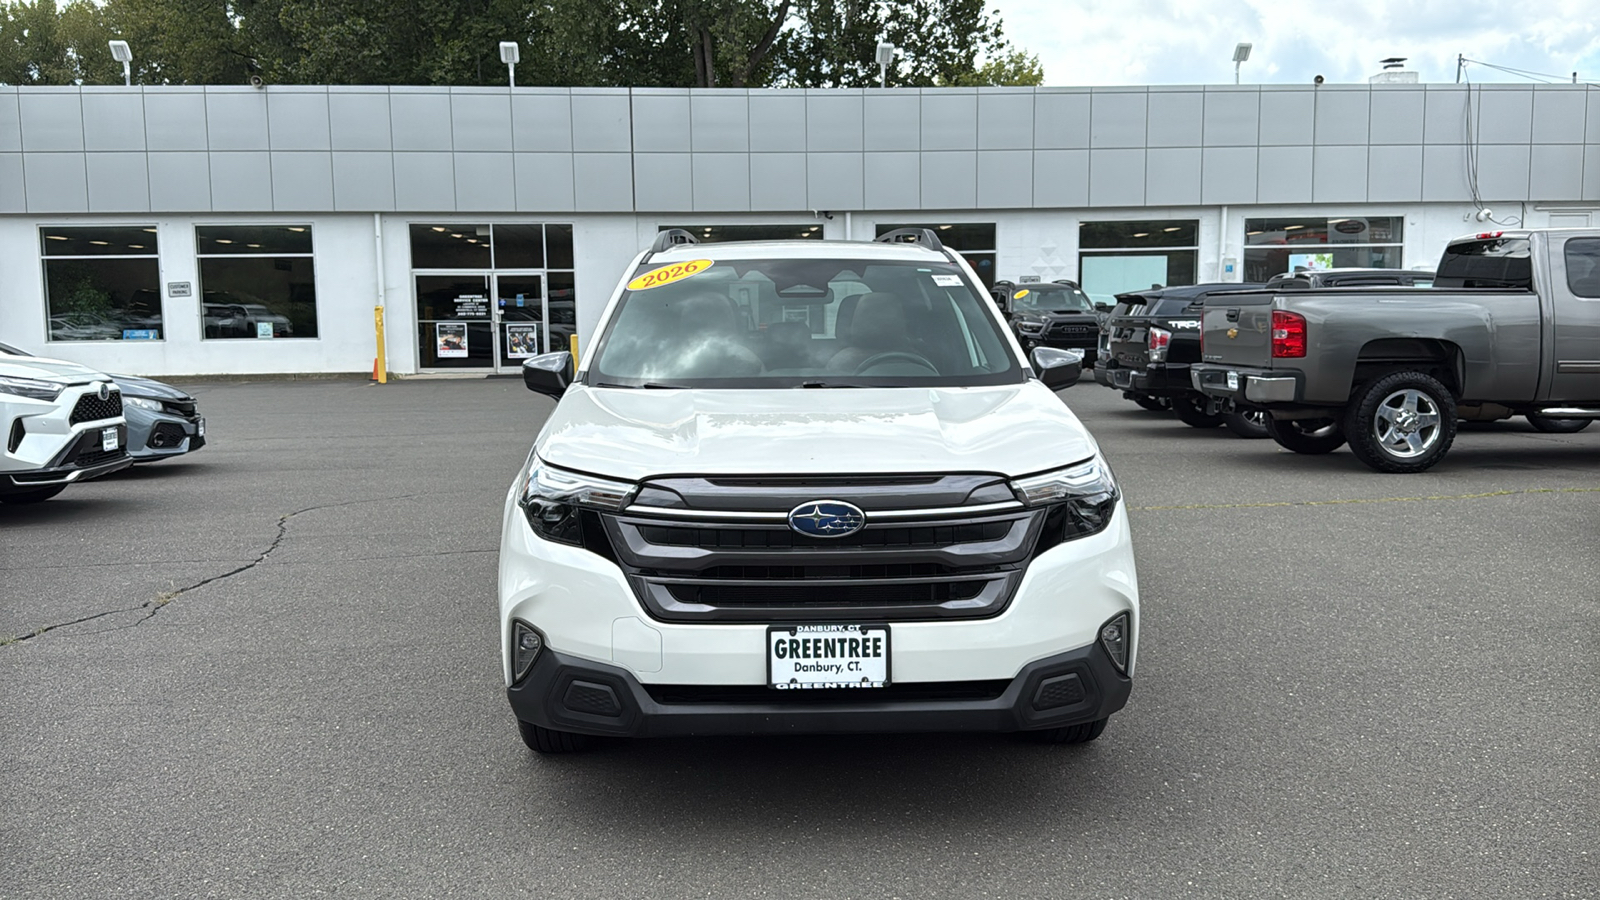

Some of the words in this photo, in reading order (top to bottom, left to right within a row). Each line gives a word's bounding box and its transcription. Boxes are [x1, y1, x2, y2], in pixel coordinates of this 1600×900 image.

[642, 261, 699, 288] 2026
[796, 625, 846, 633] DANBURY,
[847, 624, 861, 632] CT
[774, 637, 882, 660] GREENTREE
[794, 661, 844, 675] Danbury,
[847, 661, 862, 672] CT.
